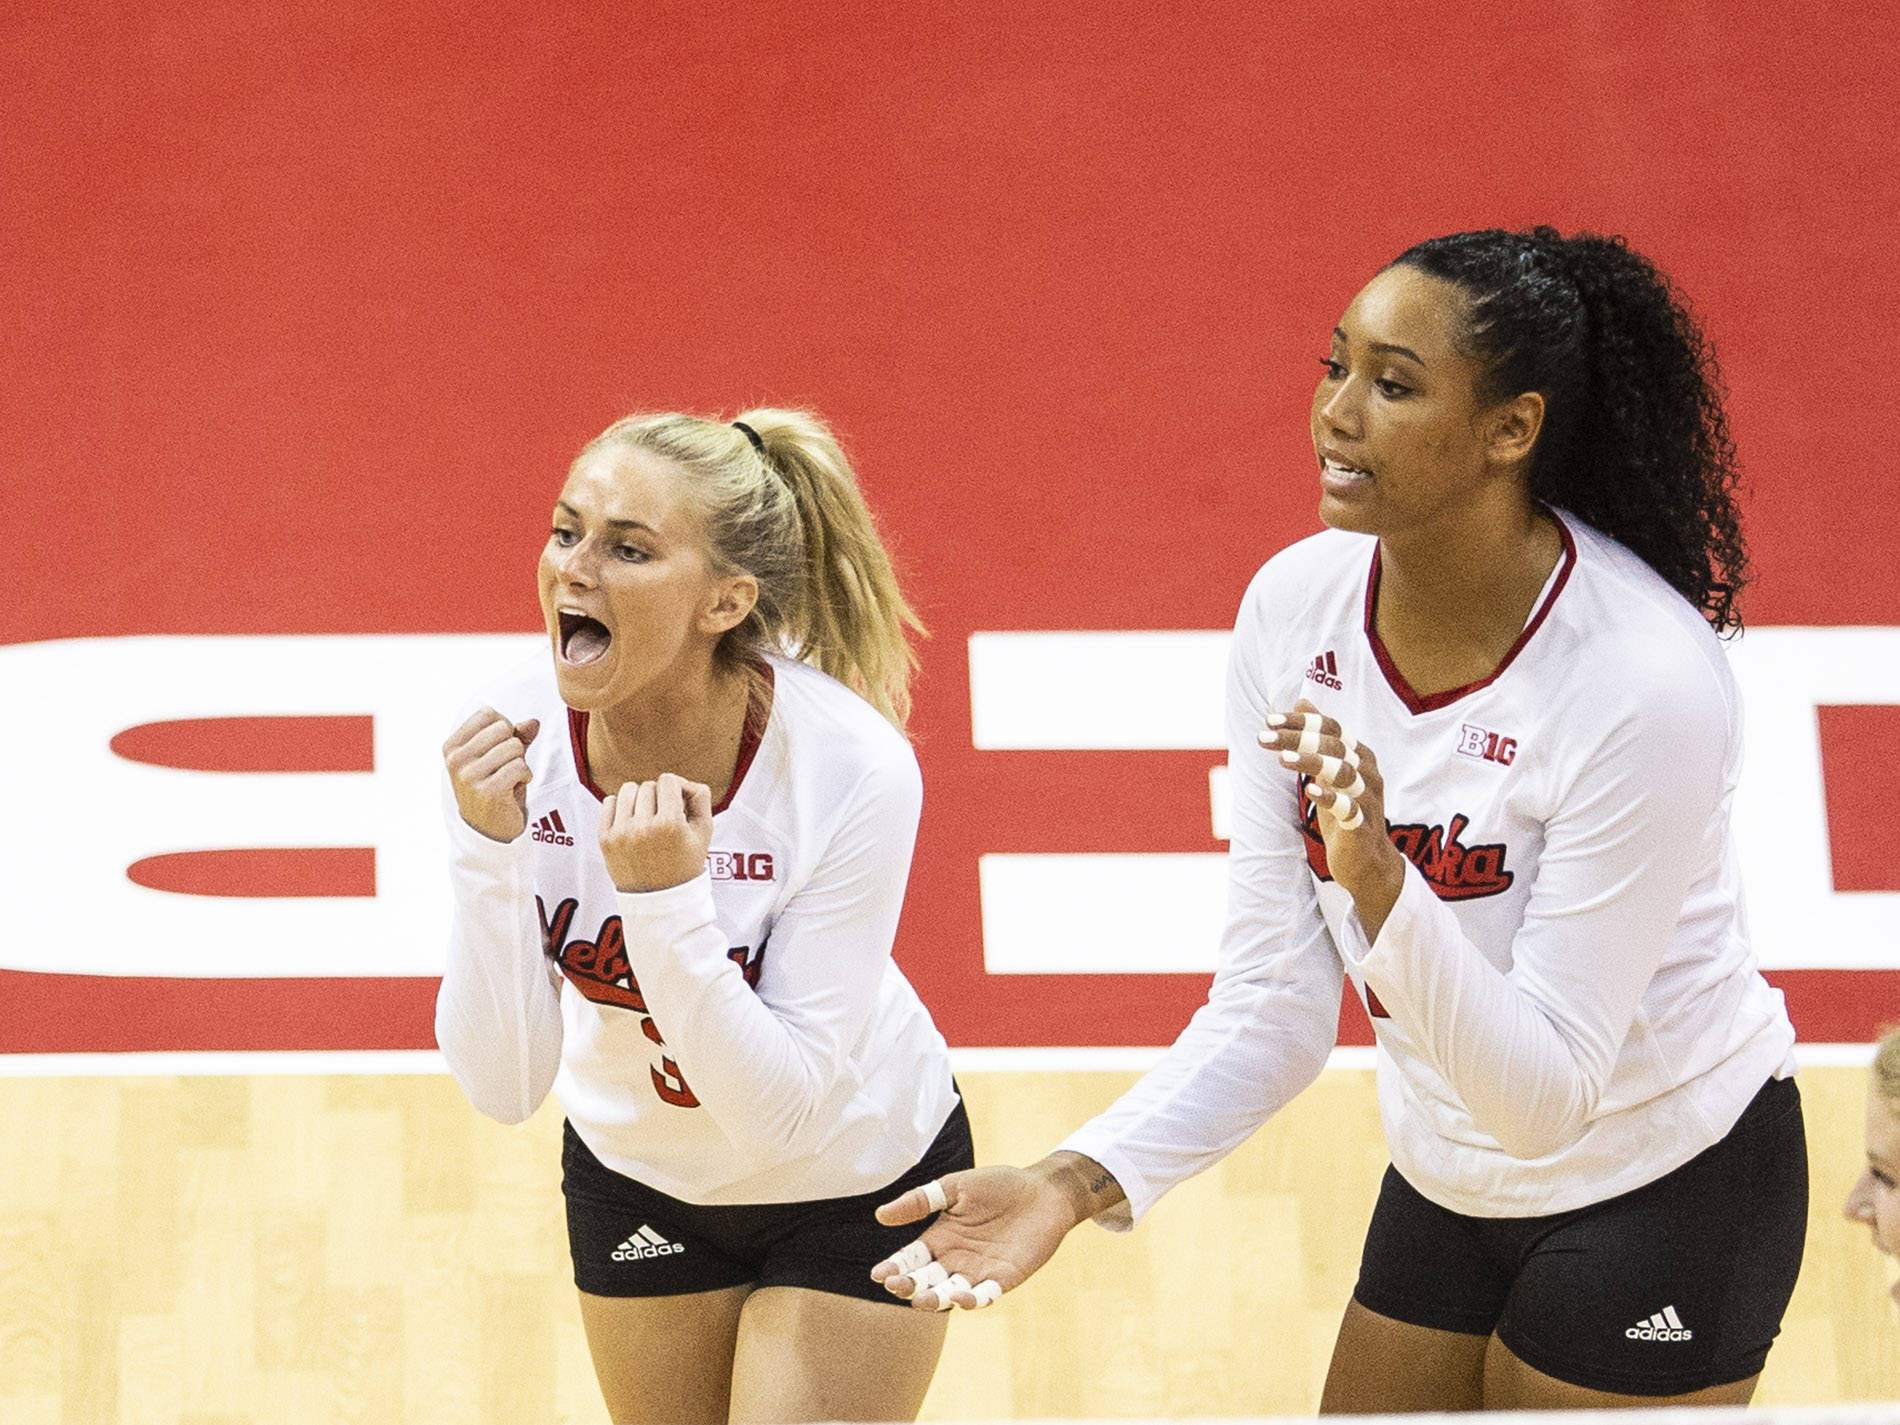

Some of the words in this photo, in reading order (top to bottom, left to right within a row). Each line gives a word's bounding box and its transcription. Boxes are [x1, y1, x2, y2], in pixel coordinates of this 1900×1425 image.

[1306, 668, 1343, 691] didas
[531, 829, 574, 847] didas
[611, 1244, 685, 1261] adidas
[1625, 1327, 1692, 1341] adidas
